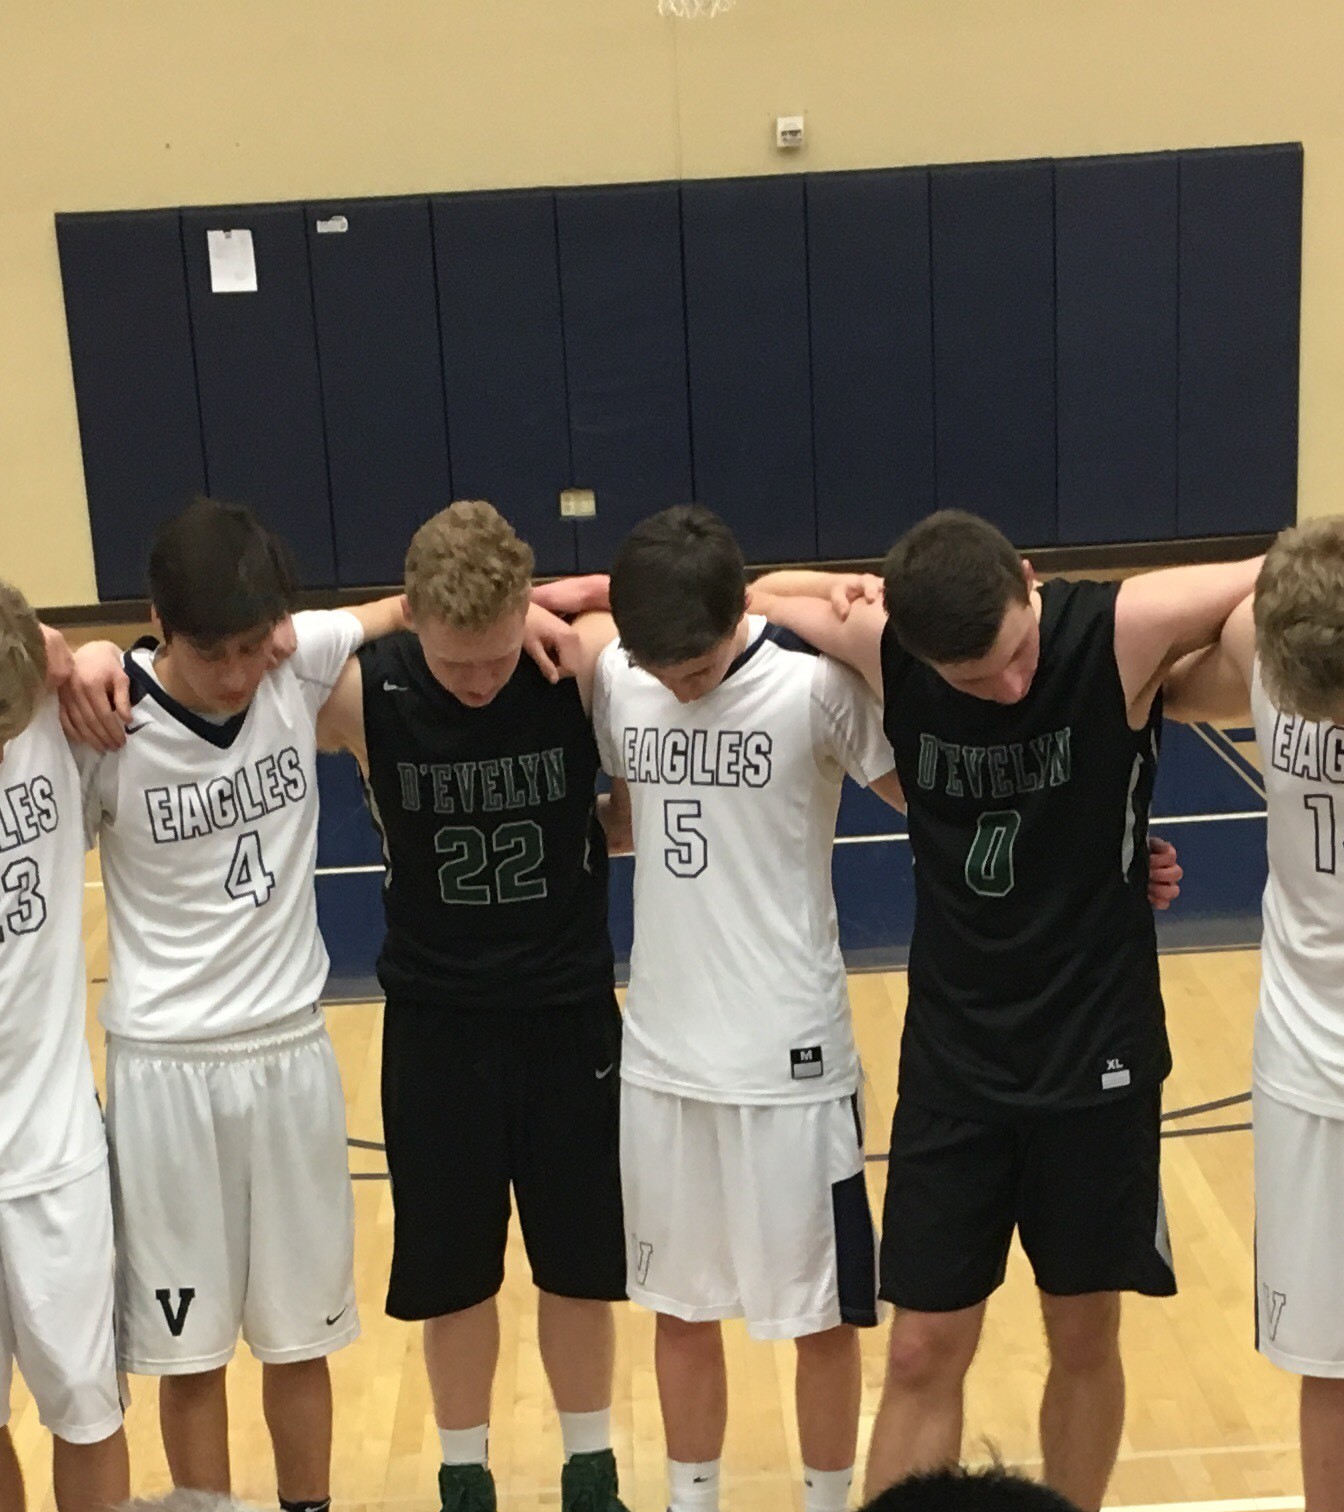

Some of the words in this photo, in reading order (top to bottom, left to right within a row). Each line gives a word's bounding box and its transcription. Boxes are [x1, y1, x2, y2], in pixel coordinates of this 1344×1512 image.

[397, 747, 566, 814] D'EVELYN
[623, 727, 773, 788] EAGLES
[144, 745, 307, 844] EAGLES
[224, 830, 276, 908] 4
[434, 819, 548, 905] 22
[663, 799, 708, 878] 5
[964, 808, 1022, 898] 0
[800, 1049, 813, 1061] M
[1106, 1058, 1124, 1071] XL
[156, 1288, 195, 1337] V
